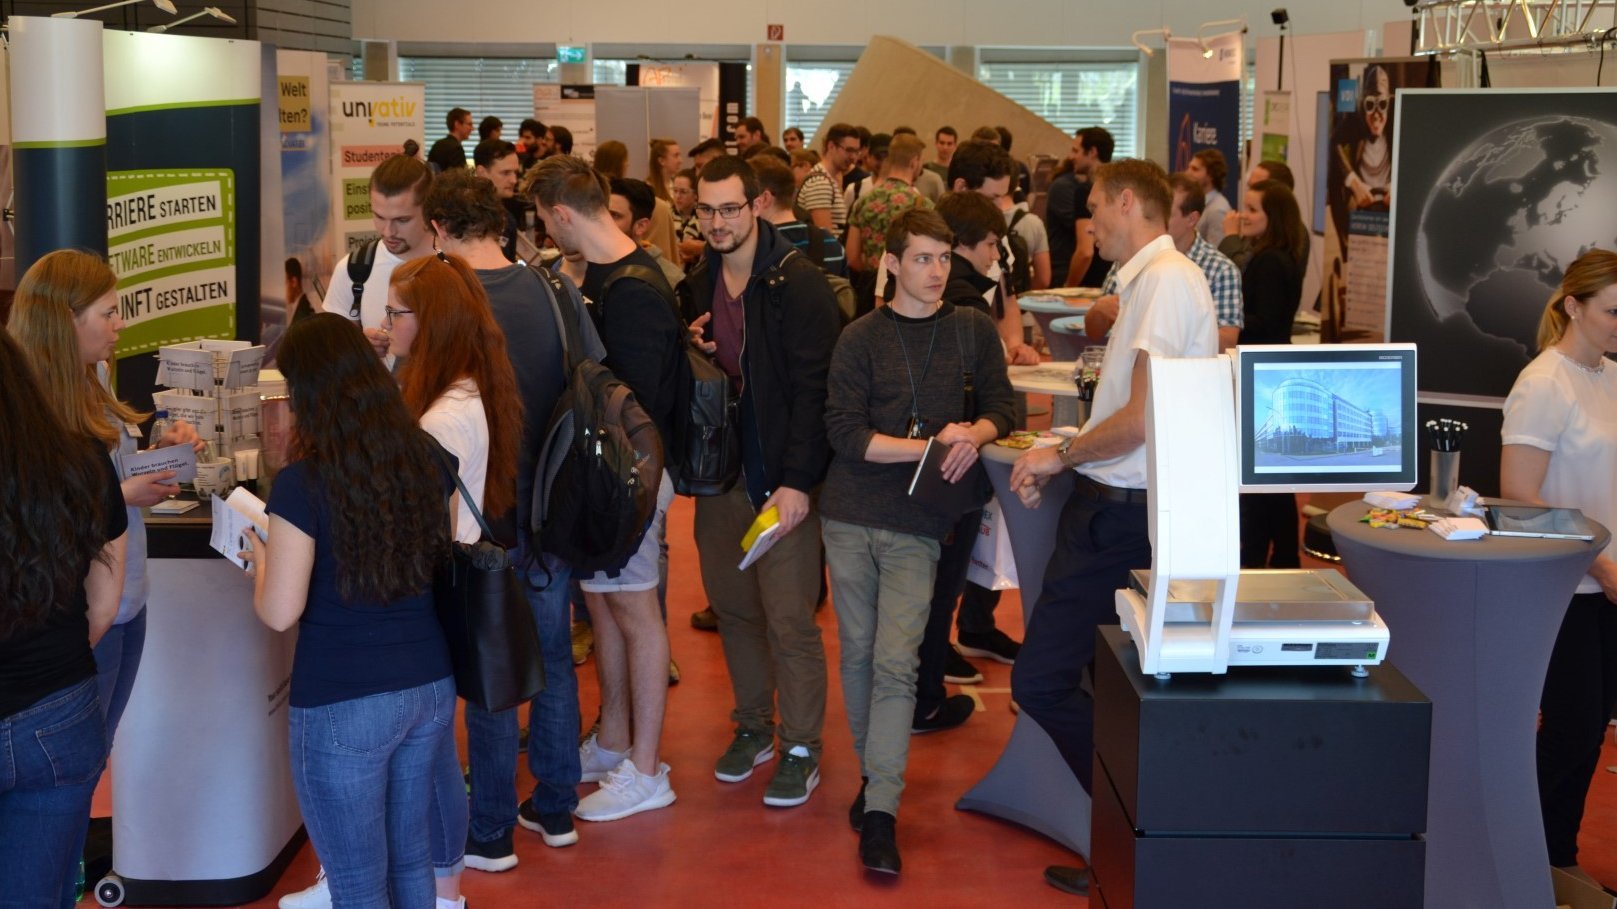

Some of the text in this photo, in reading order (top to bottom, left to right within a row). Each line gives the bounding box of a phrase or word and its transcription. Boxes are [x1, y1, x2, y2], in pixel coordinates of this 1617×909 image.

[280, 82, 306, 97] Welt
[278, 108, 308, 123] lten?
[344, 150, 400, 163] Studente
[107, 194, 216, 230] RRIERE STARTEN
[158, 240, 221, 263] ENTWICKELN
[156, 280, 228, 311] GESTALTEN
